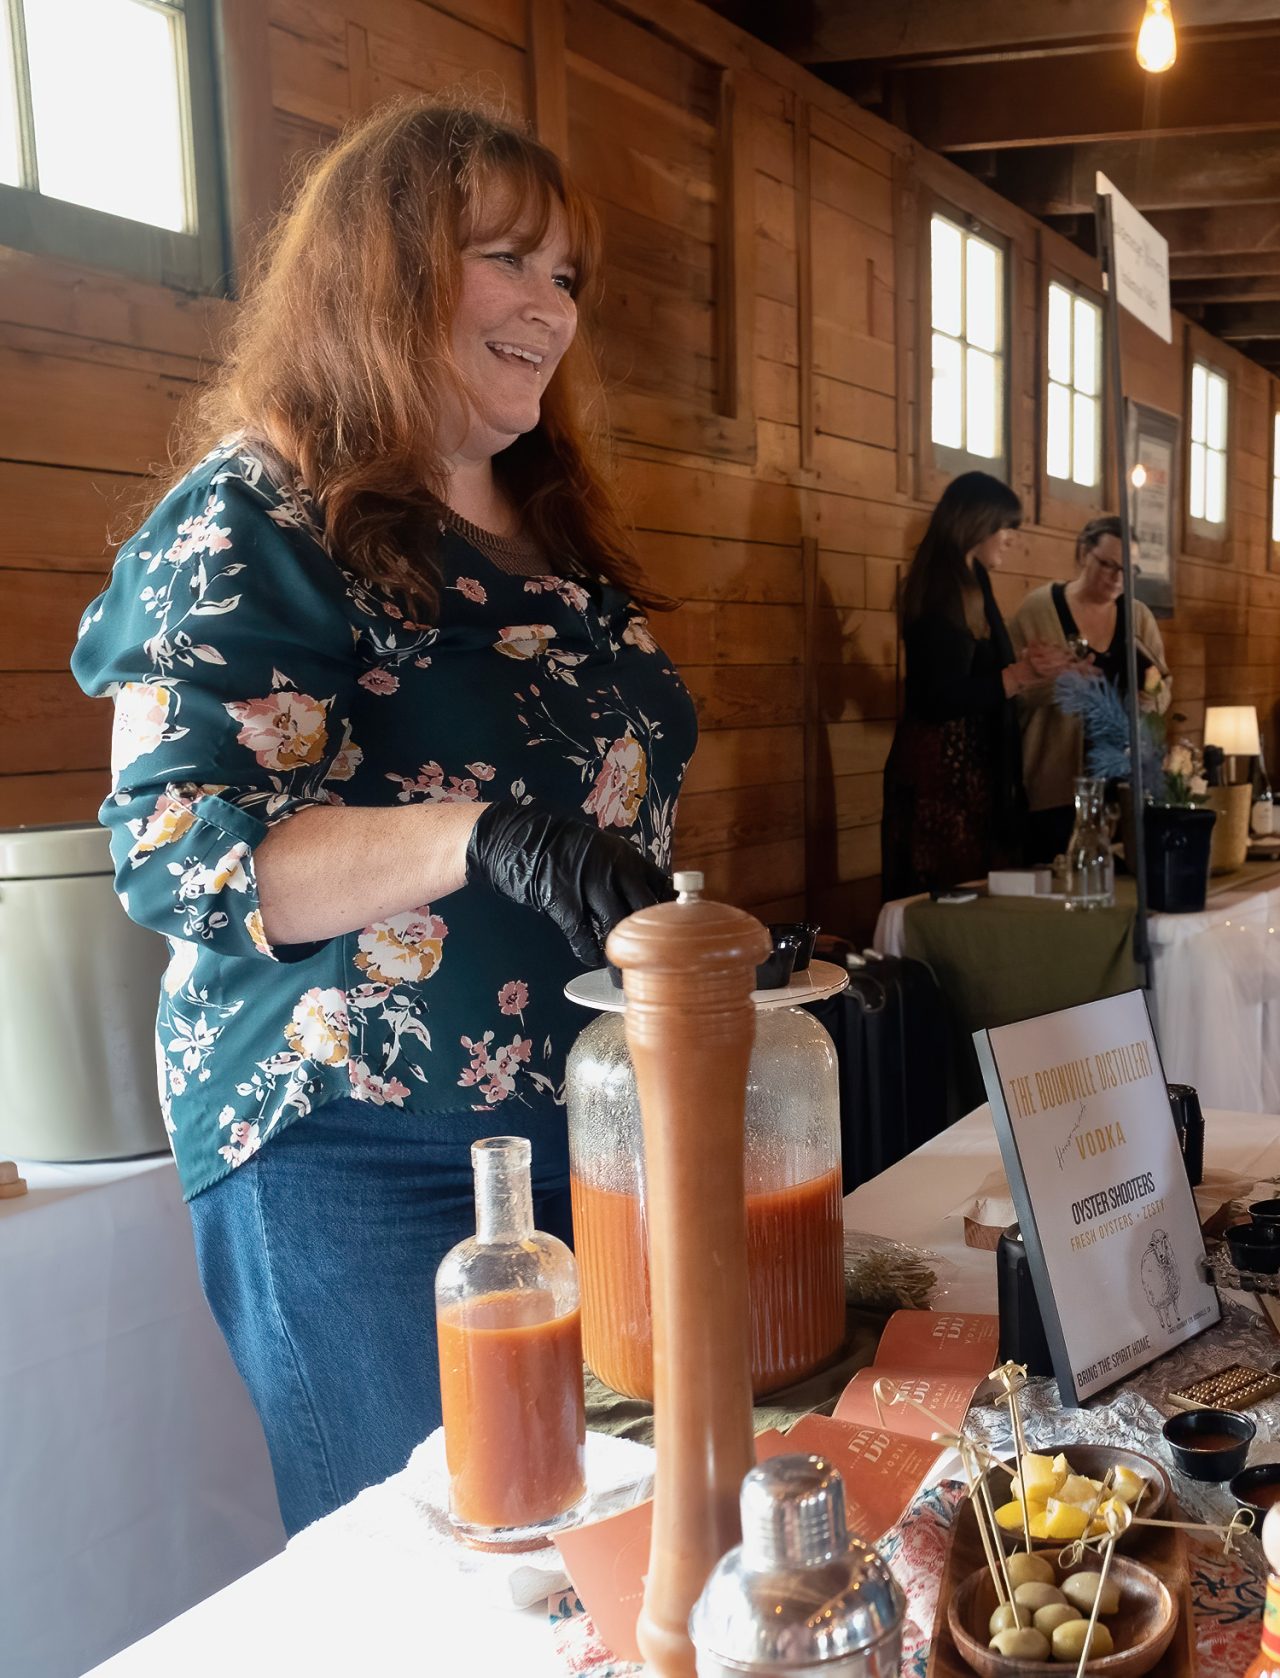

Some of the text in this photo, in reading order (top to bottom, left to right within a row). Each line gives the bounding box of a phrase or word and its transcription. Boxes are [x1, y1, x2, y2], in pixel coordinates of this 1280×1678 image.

[1009, 1040, 1154, 1119] THE BOONVILLE DISTILLERY
[1075, 1121, 1127, 1160] VODKA
[1070, 1198, 1167, 1252] FRESH OYSTERS ZESTY
[1071, 1171, 1156, 1225] OYSTER SHOOTERS
[1076, 1334, 1151, 1388] BRING THE SPIRIT HOME
